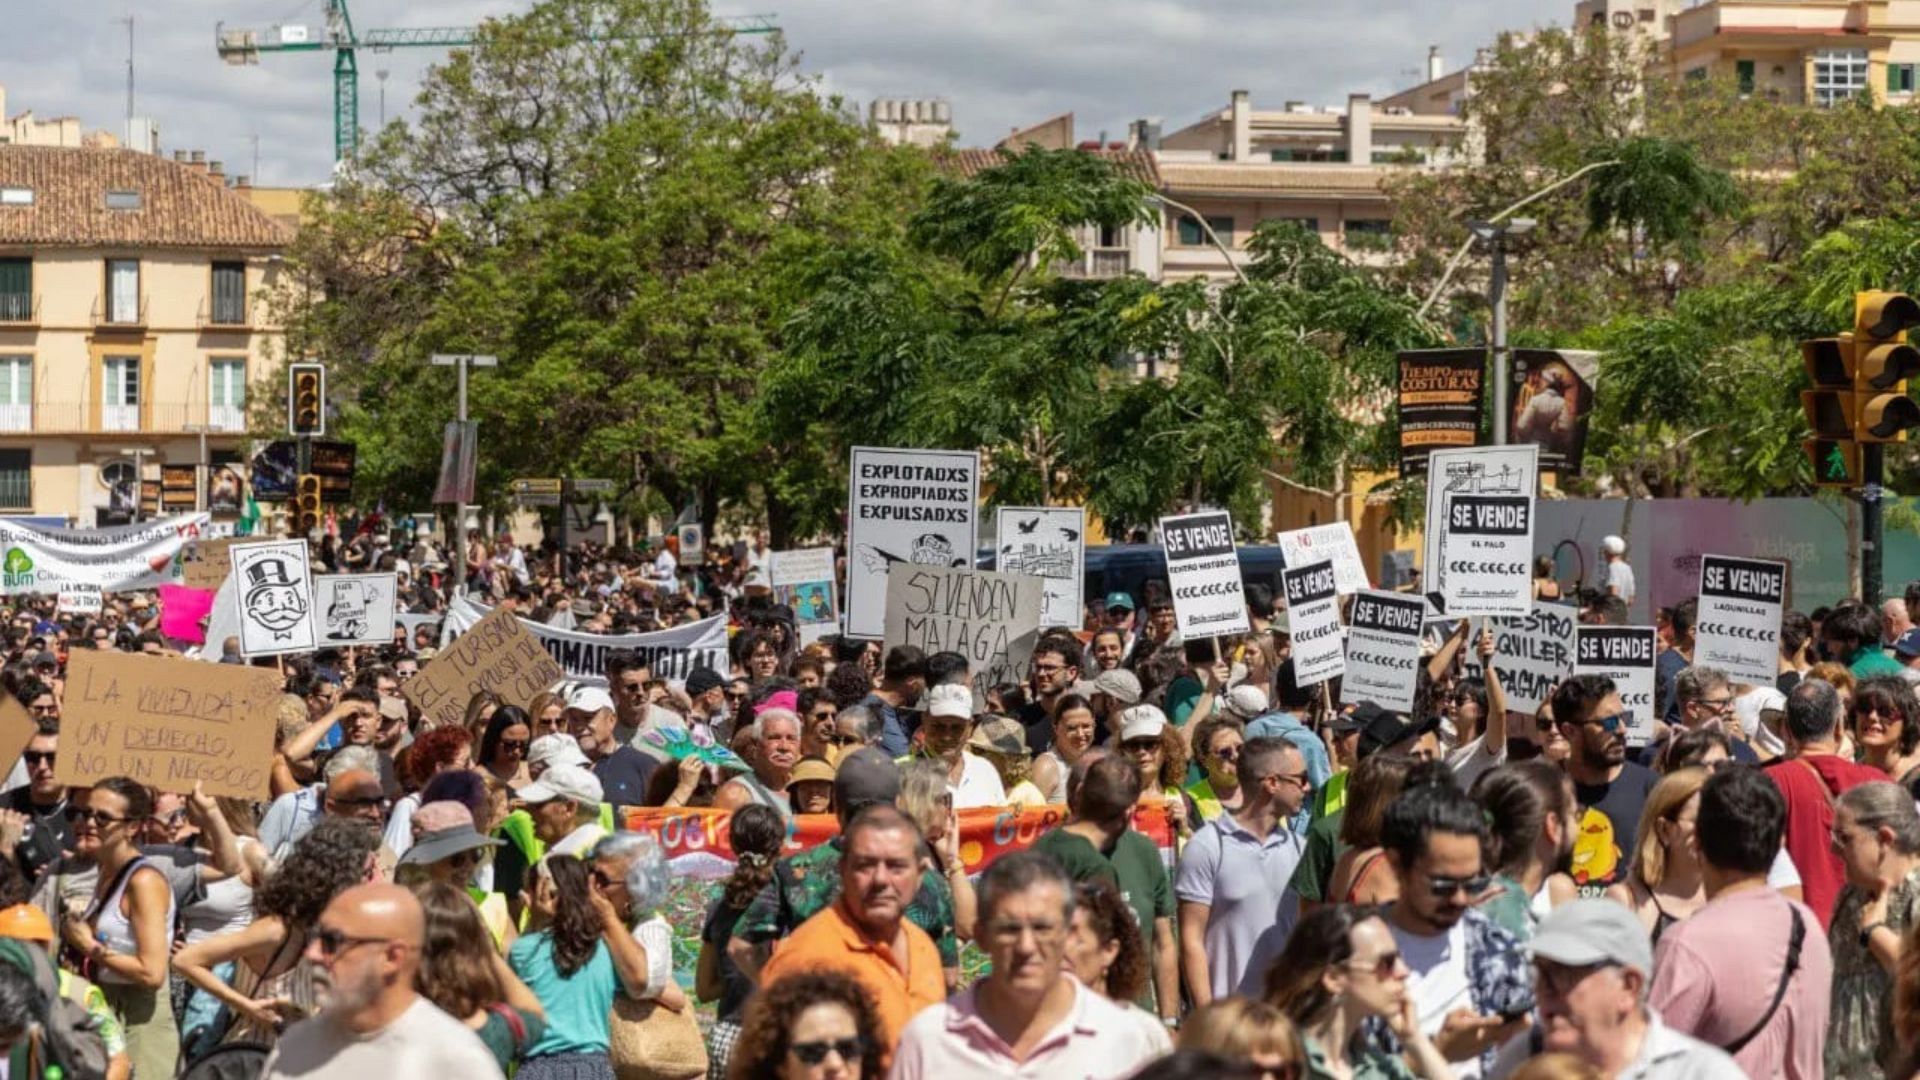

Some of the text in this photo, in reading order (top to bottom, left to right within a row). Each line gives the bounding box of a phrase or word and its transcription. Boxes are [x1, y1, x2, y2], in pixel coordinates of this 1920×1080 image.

[1400, 377, 1479, 391] COSTURAS
[1402, 366, 1451, 379] TIEMPO
[861, 464, 969, 483] EXPLOTADXS
[860, 484, 968, 502] EXPROPIADXS
[860, 504, 968, 523] EXPULSADXS
[1452, 504, 1525, 529] SE VENDE
[1167, 524, 1229, 552] SE VENDE
[1288, 567, 1335, 600] SE VENDE
[1705, 566, 1780, 596] SE VENDE
[1357, 601, 1420, 630] SE VENDE
[1714, 603, 1767, 616] LAGUNILLAS
[1490, 609, 1573, 639] ESTRO
[414, 612, 519, 709] EL TURISMO
[1580, 637, 1650, 660] SE VENDE
[83, 665, 120, 704] LA
[75, 720, 113, 746] UN
[74, 752, 262, 791] NO UN NEGOCIO
